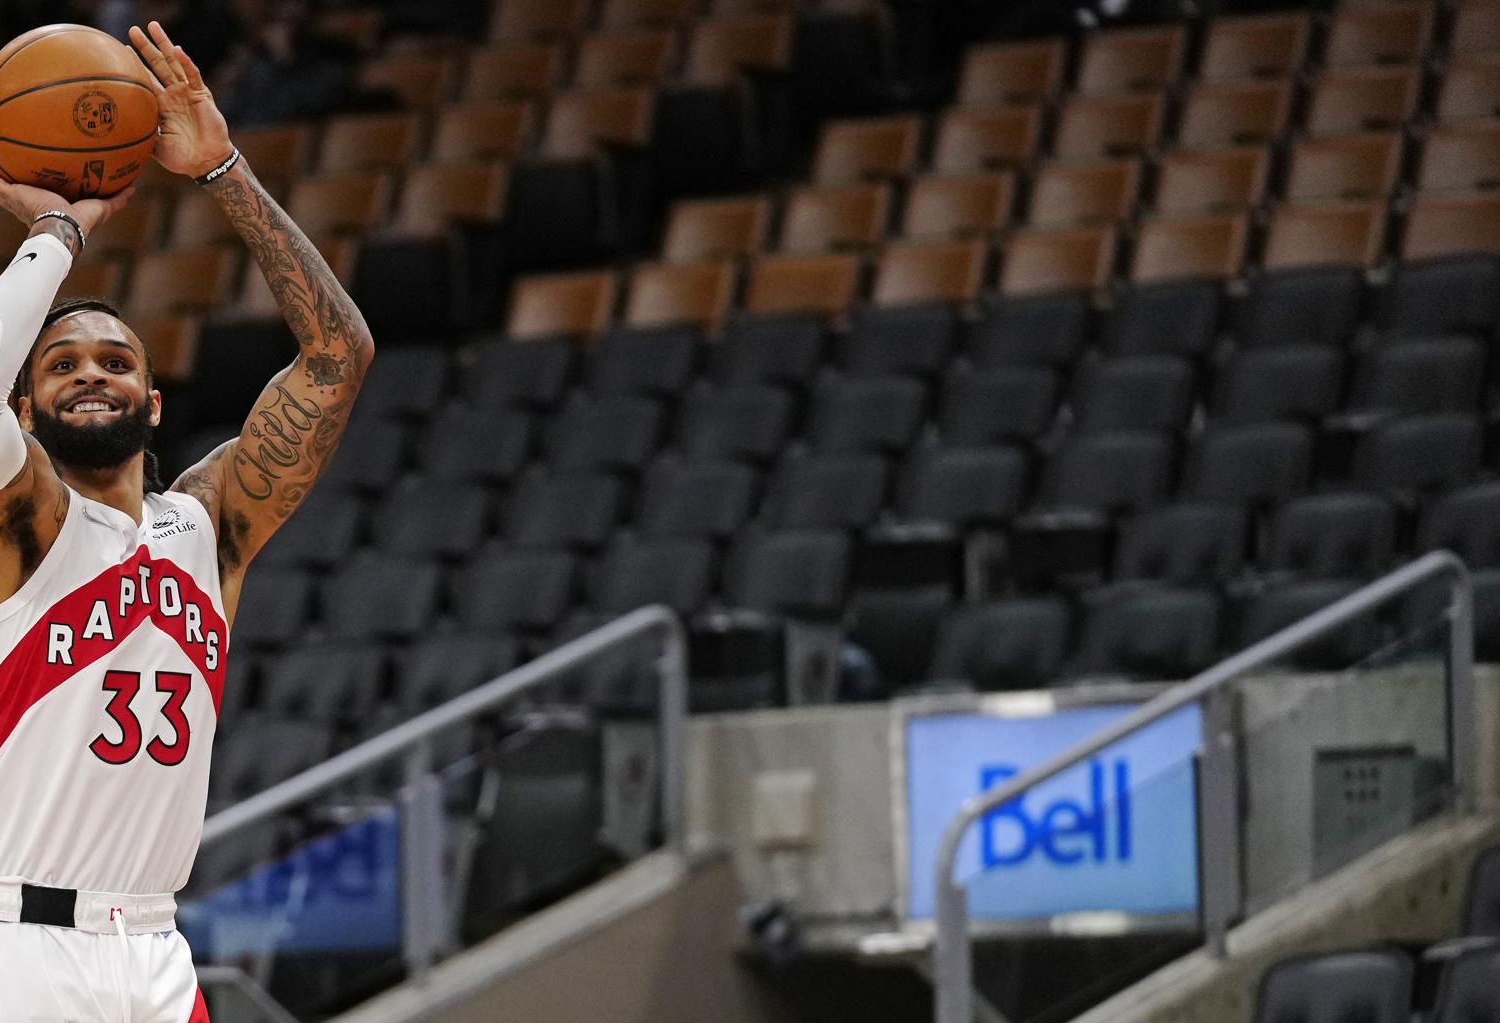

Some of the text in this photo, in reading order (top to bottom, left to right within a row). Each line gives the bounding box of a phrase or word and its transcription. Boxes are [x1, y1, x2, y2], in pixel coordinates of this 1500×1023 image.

[233, 386, 321, 500] Child
[152, 521, 197, 540] Sun Life
[47, 564, 219, 671] RAPTORS
[88, 670, 192, 766] 33
[979, 755, 1131, 870] Bell
